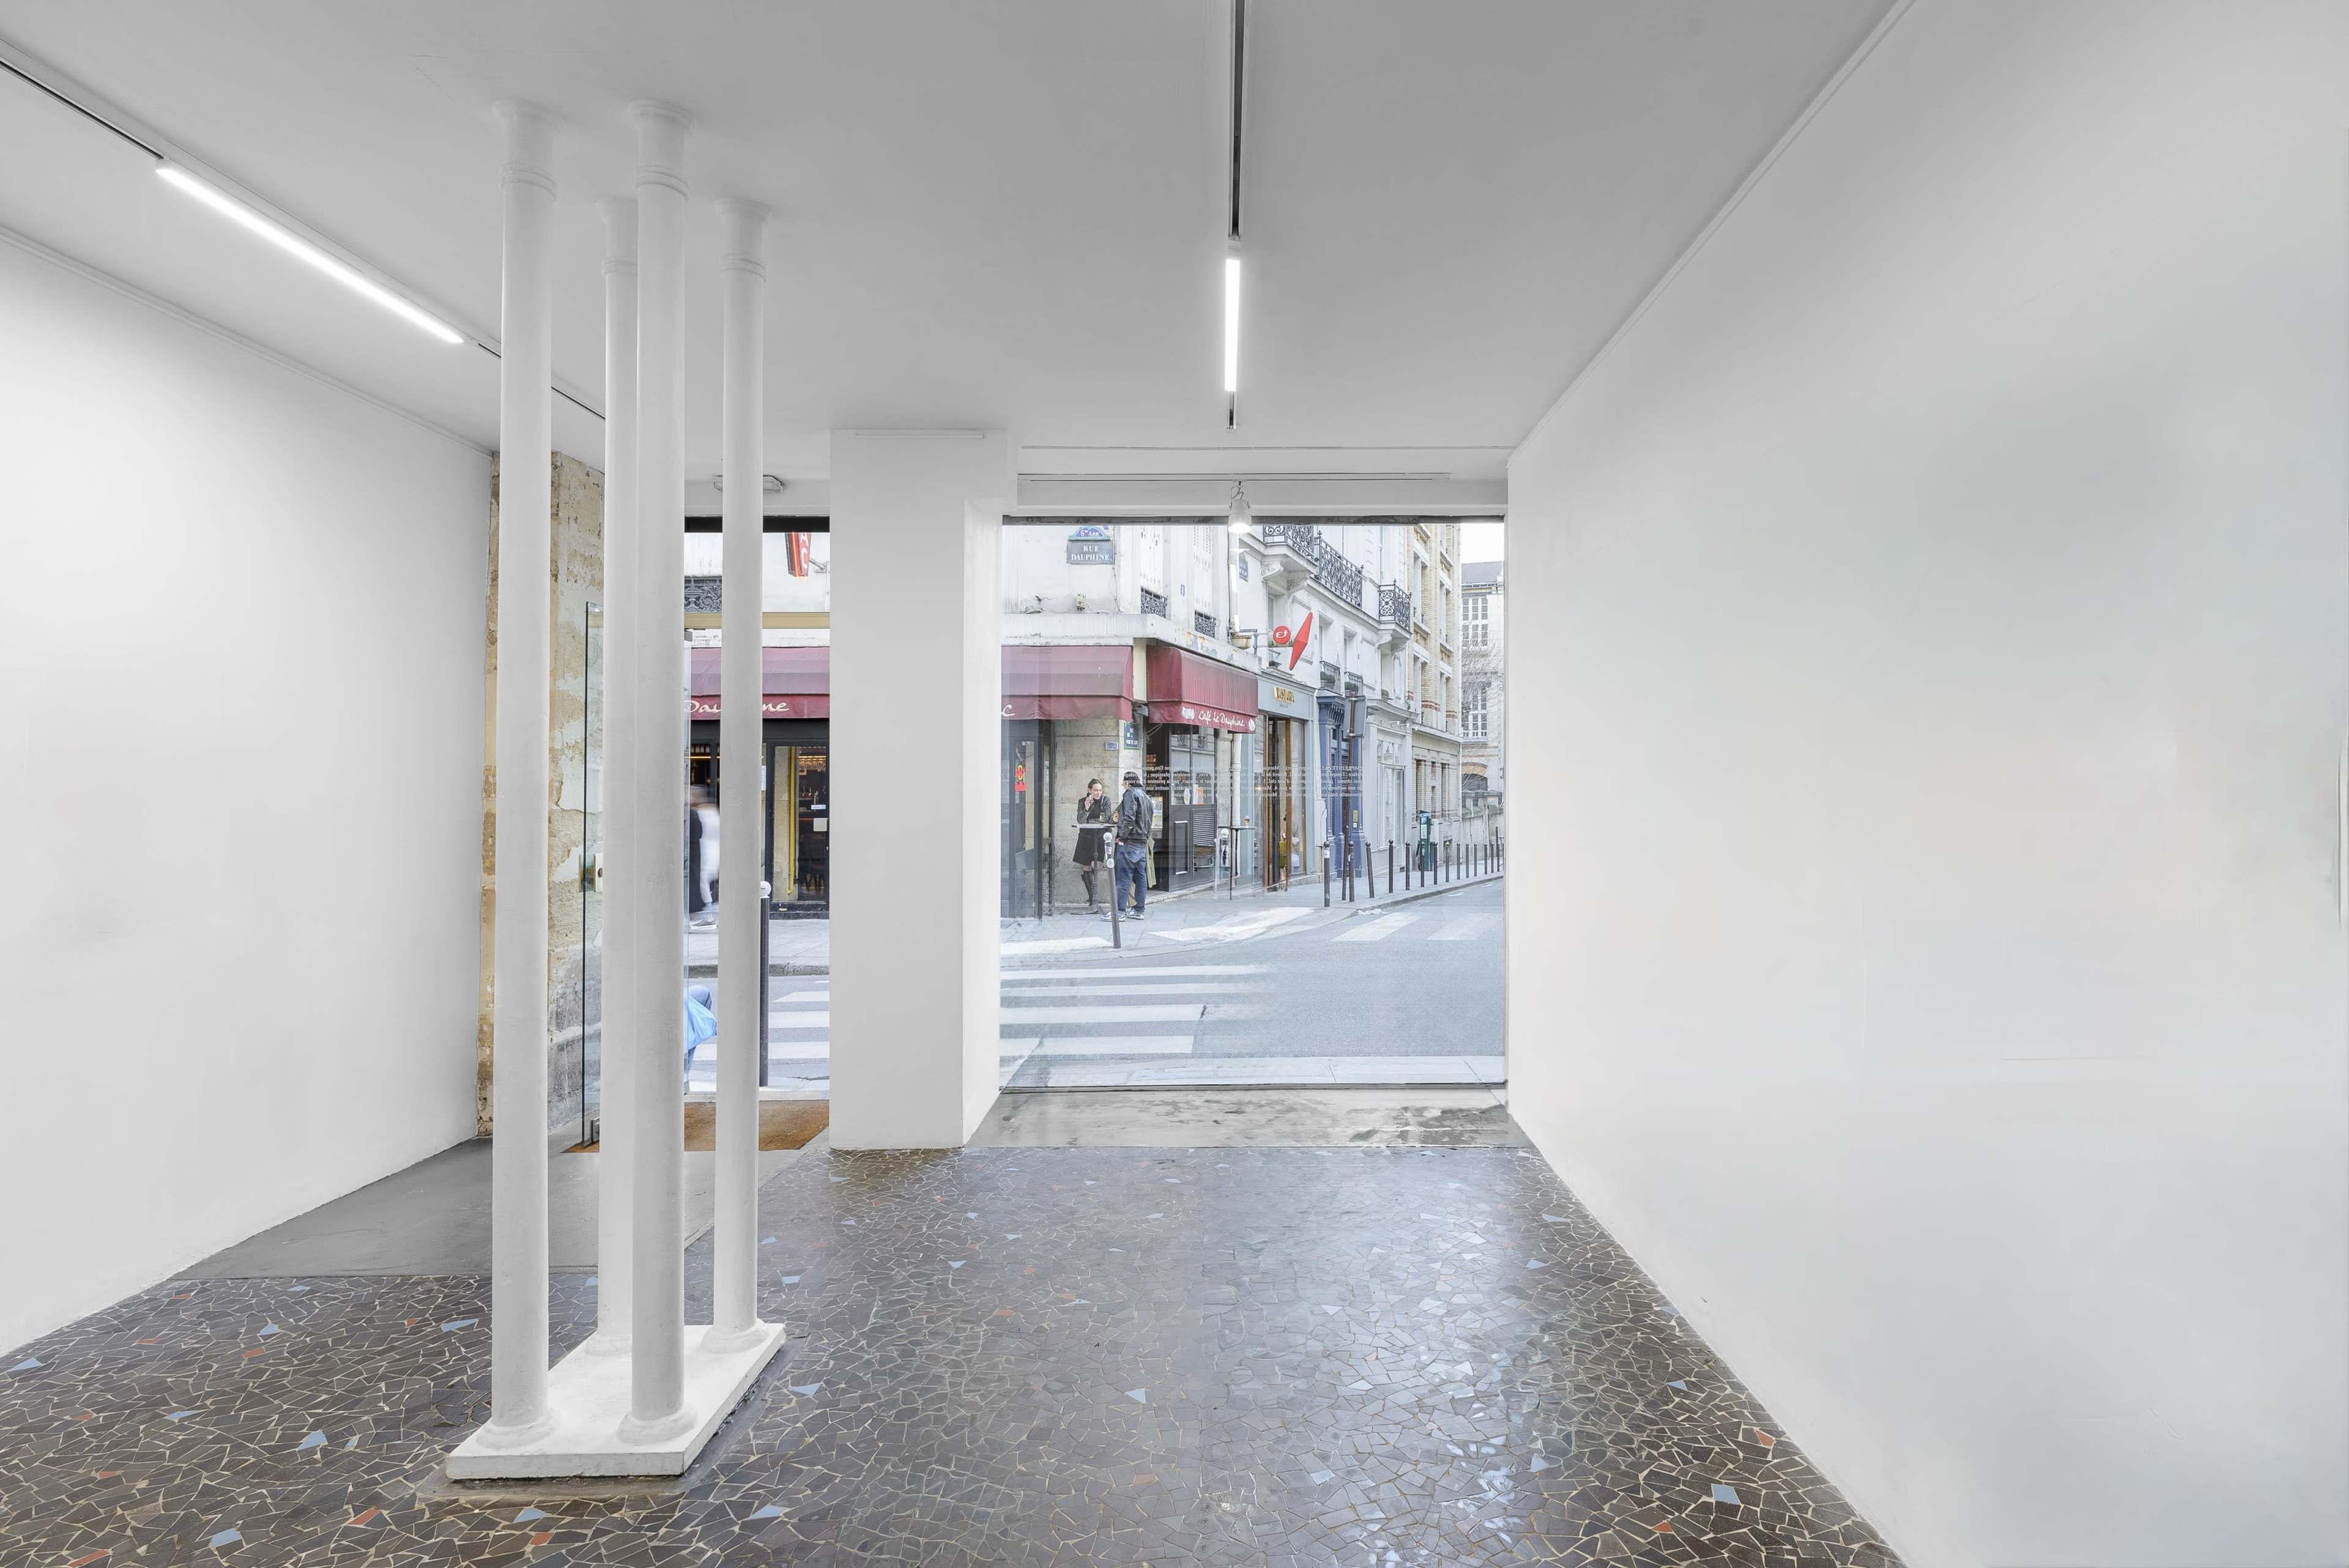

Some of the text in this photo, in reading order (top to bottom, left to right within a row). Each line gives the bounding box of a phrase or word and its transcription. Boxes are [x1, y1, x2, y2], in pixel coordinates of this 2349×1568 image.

[1198, 710, 1245, 729] Café Le Dauphine
